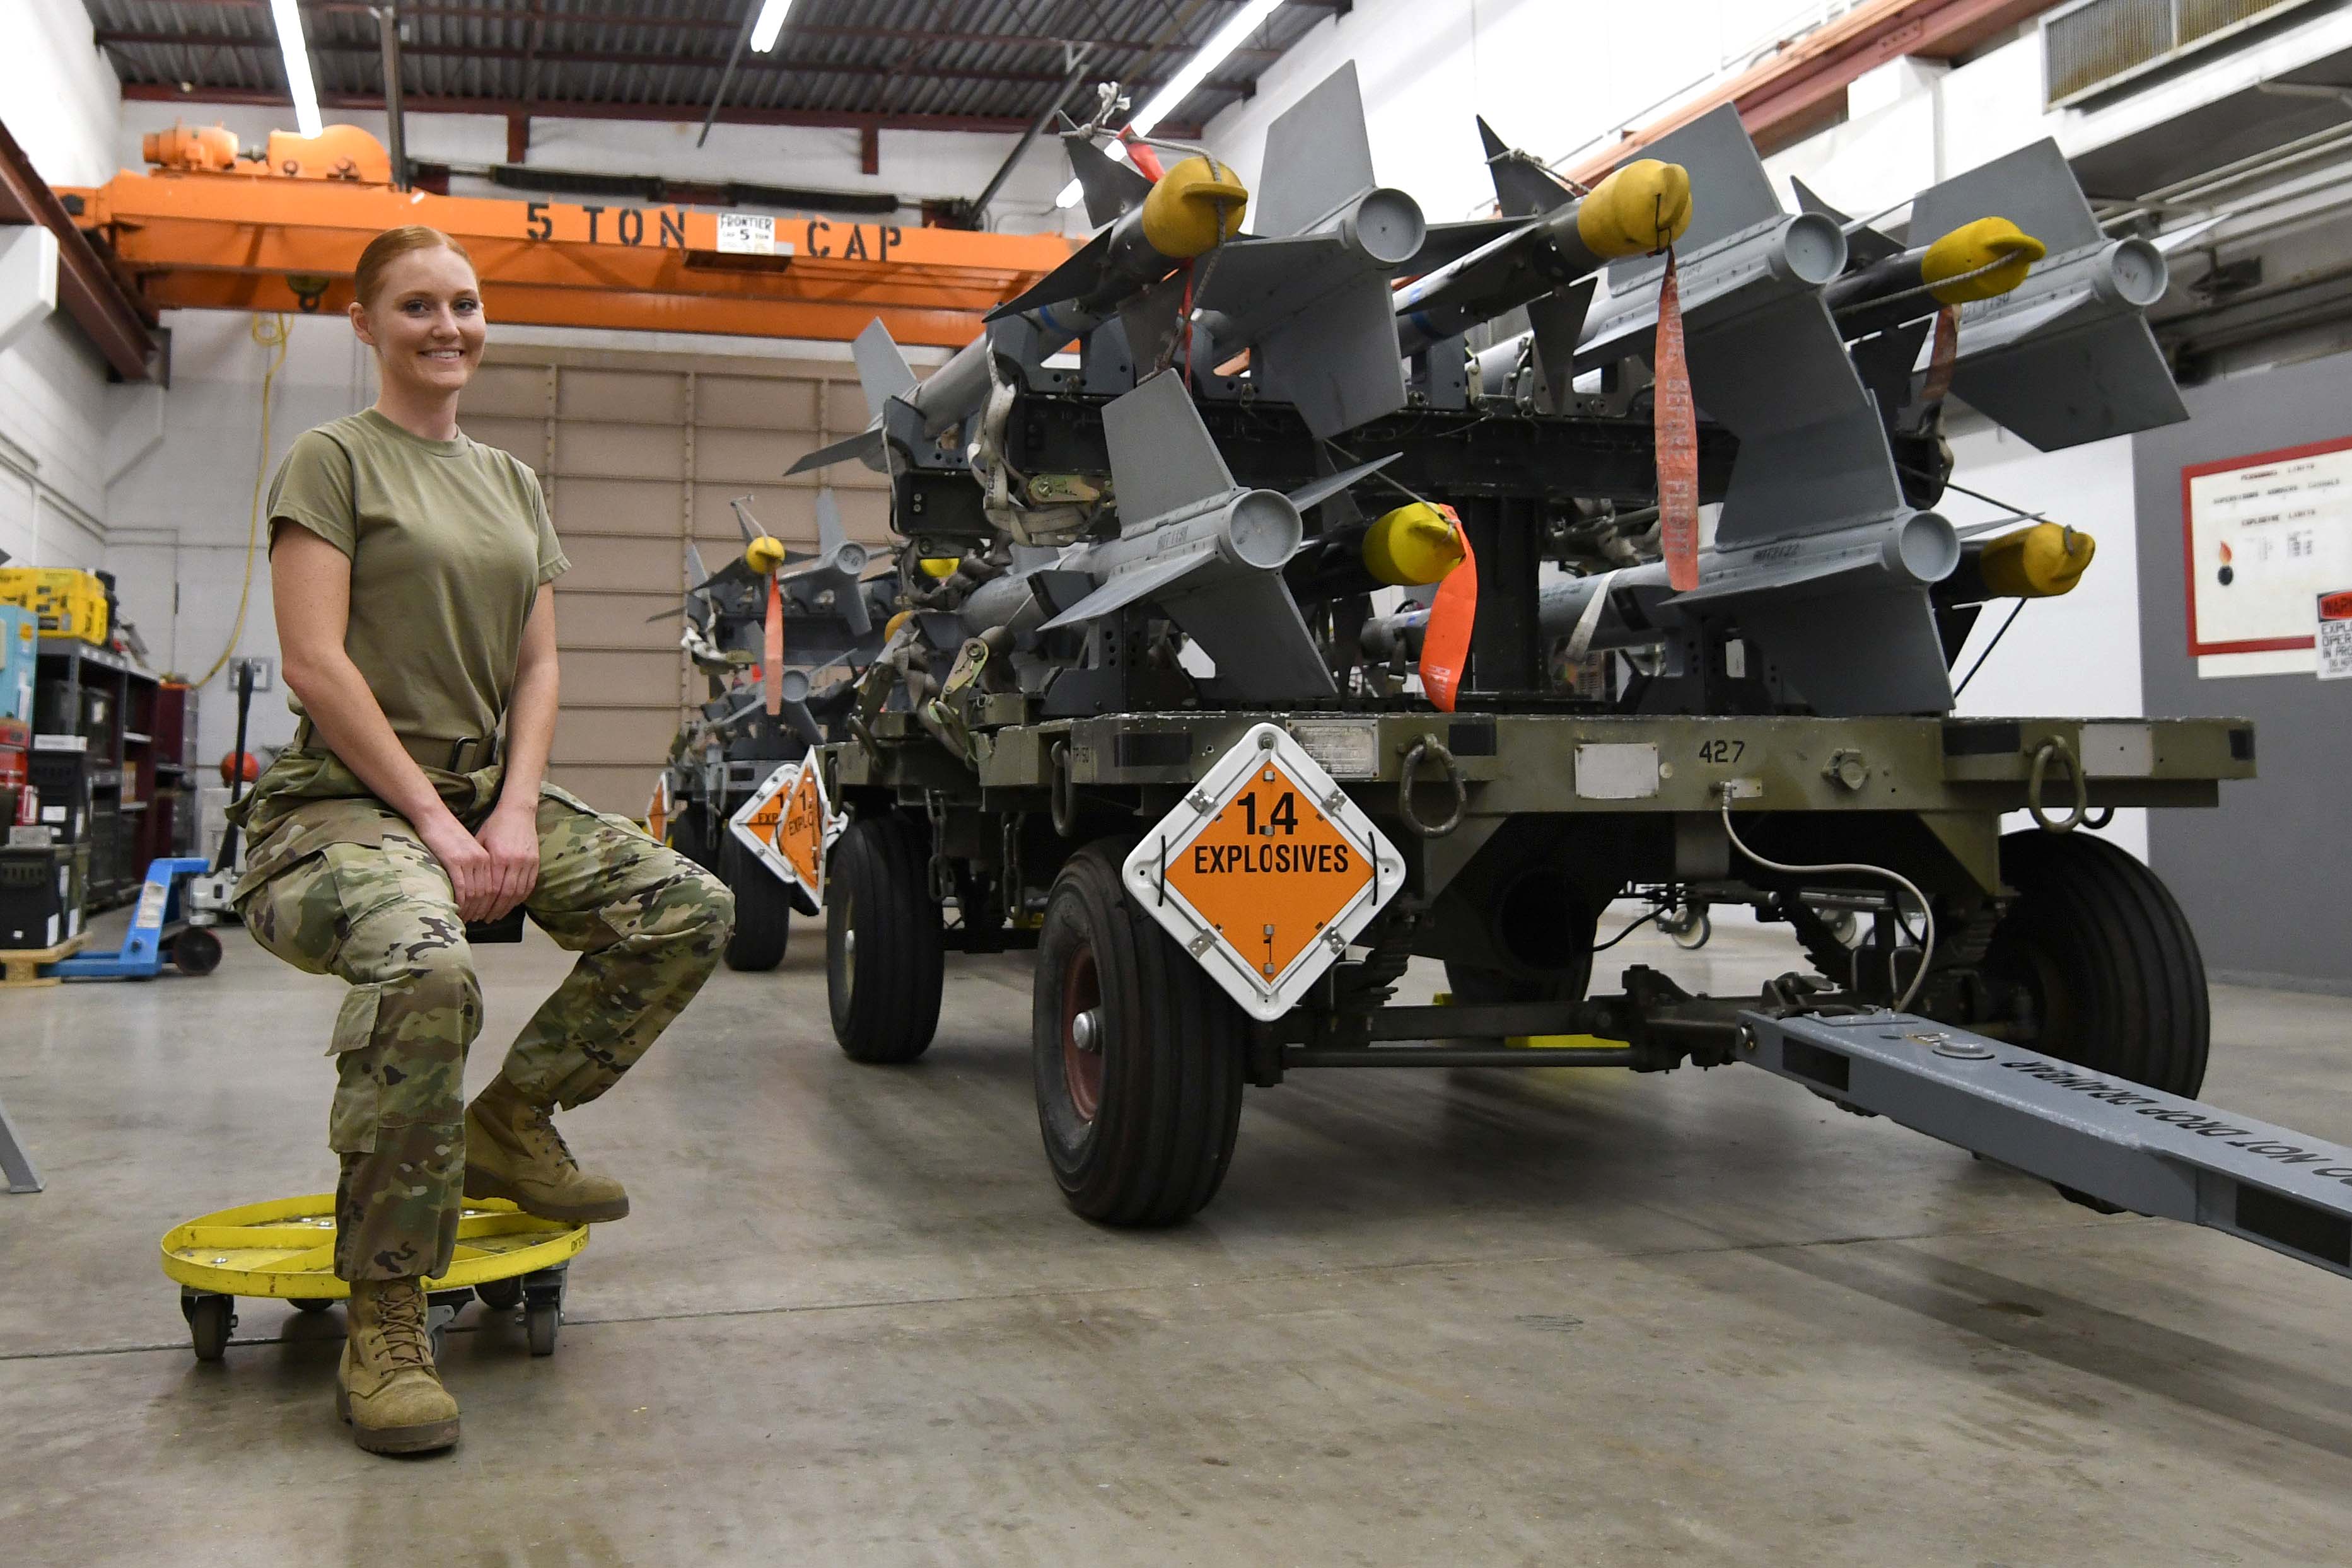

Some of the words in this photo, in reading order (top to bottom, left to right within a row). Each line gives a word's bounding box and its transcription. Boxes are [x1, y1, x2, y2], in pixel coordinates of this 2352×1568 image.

[525, 202, 552, 242] 5
[583, 206, 685, 250] TON
[806, 221, 902, 262] CAP
[740, 228, 750, 240] 5
[1699, 740, 1745, 764] 427
[1238, 792, 1298, 835] 1.4
[1194, 844, 1349, 873] EXPLOSIVES
[2000, 1061, 2160, 1105] DRAWBAR
[2134, 1108, 2253, 1136] DROP
[2224, 1141, 2334, 1164] NOT
